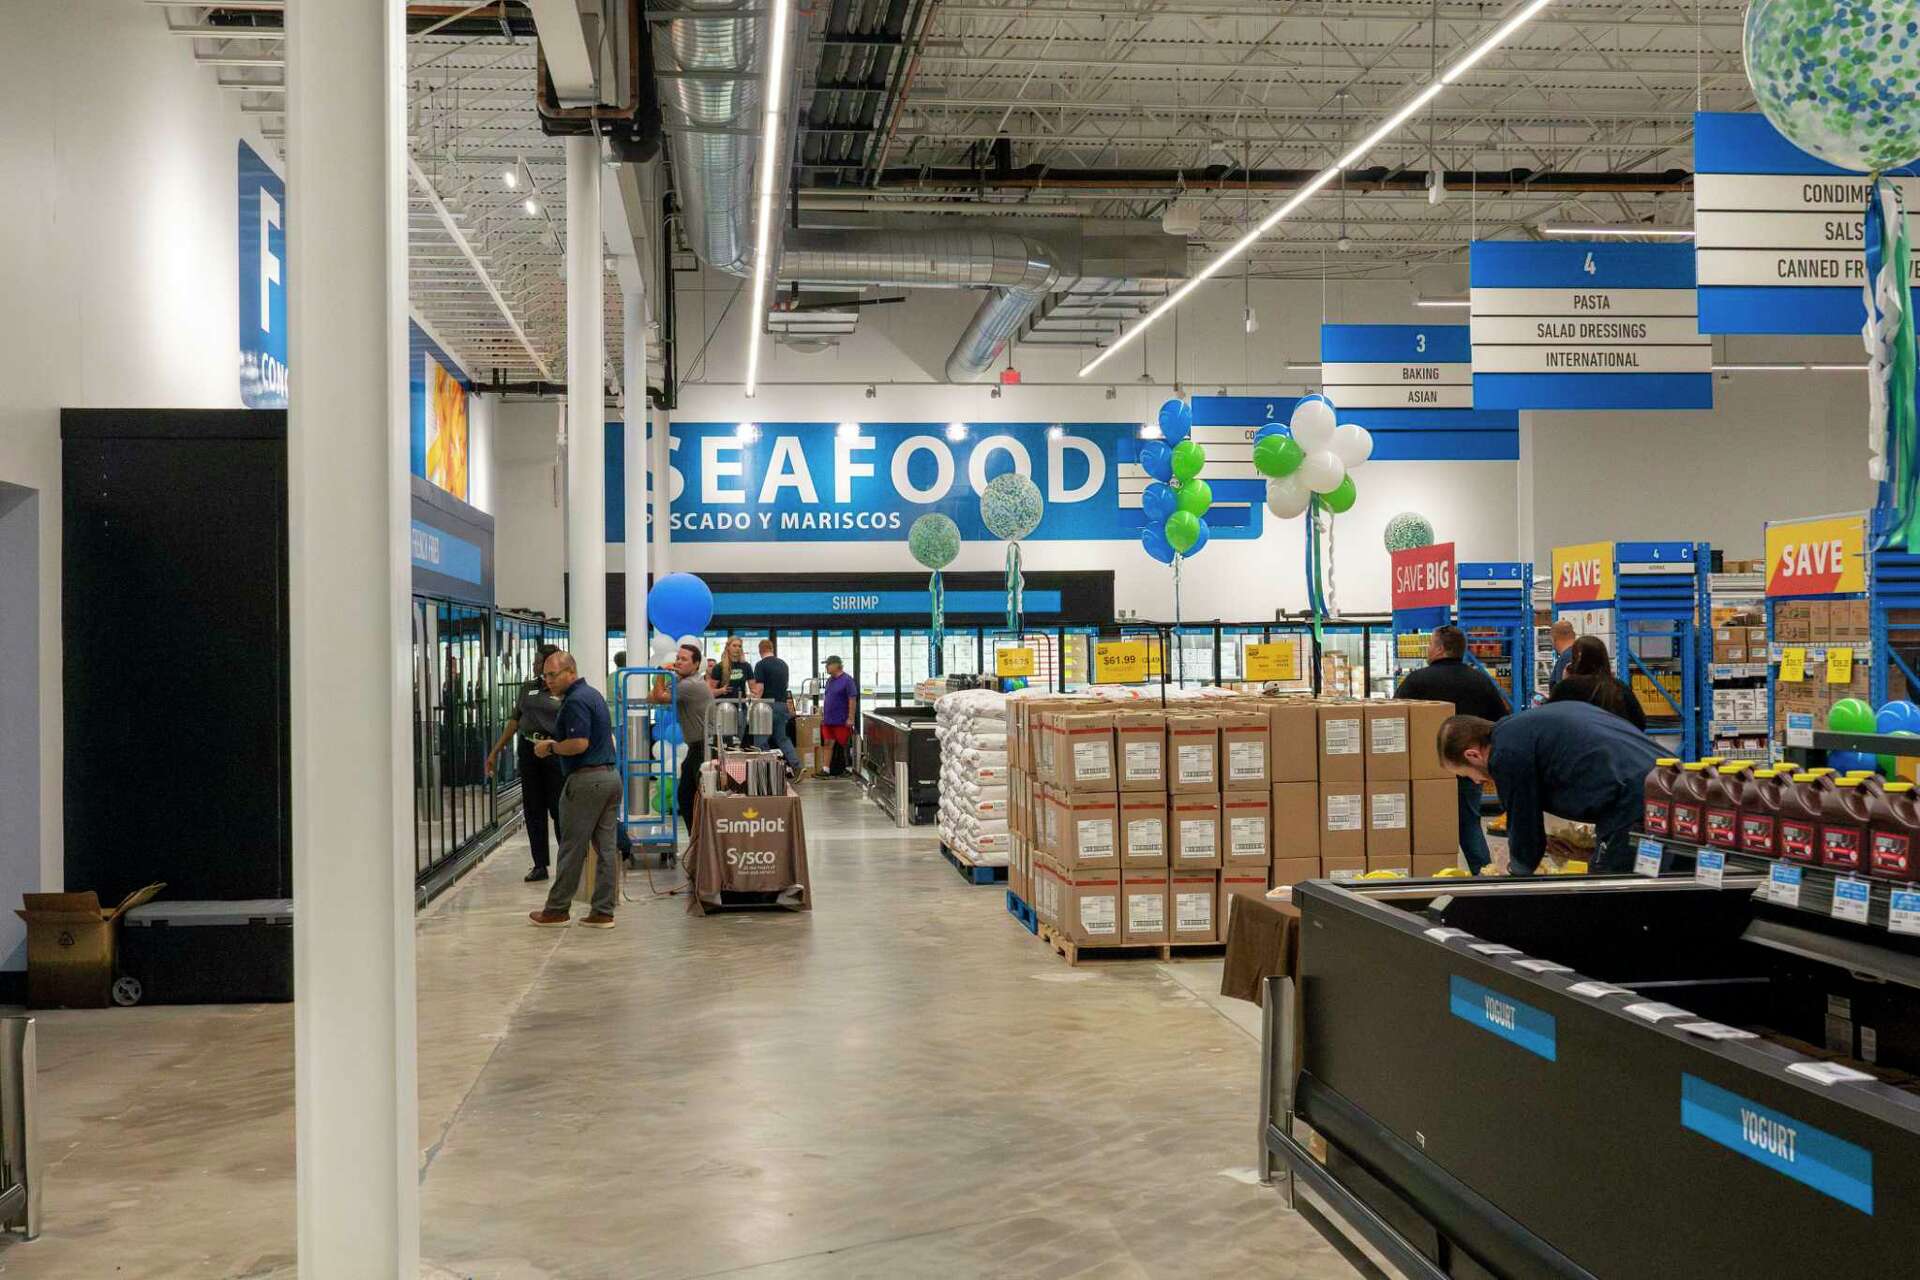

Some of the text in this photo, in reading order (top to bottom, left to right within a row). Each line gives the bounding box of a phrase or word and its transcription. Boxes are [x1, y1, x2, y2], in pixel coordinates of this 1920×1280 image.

[1803, 183, 1904, 204] CONDIMES
[1825, 221, 1864, 241] SALS
[1583, 251, 1597, 275] 4
[1777, 259, 1839, 278] CANNED
[1573, 295, 1610, 310] PASTA
[1537, 323, 1647, 338] SALAD DRESSINGS
[1415, 333, 1426, 353] 3
[1546, 352, 1640, 367] INTERNATIONAL
[1402, 367, 1440, 380] BAKING
[1407, 390, 1438, 403] ASIAN
[1265, 403, 1275, 419] 2
[758, 511, 772, 529] Y
[780, 510, 901, 530] MARISCOS
[1782, 540, 1844, 577] SAVE
[1396, 560, 1450, 594] SAVE BIG
[1562, 558, 1601, 588] SAVE
[832, 595, 879, 610] SHRIMP
[716, 817, 785, 838] Simplot
[726, 847, 776, 869] Sysco
[1484, 994, 1516, 1031] YOGURT
[1741, 1107, 1797, 1163] YOGURT
